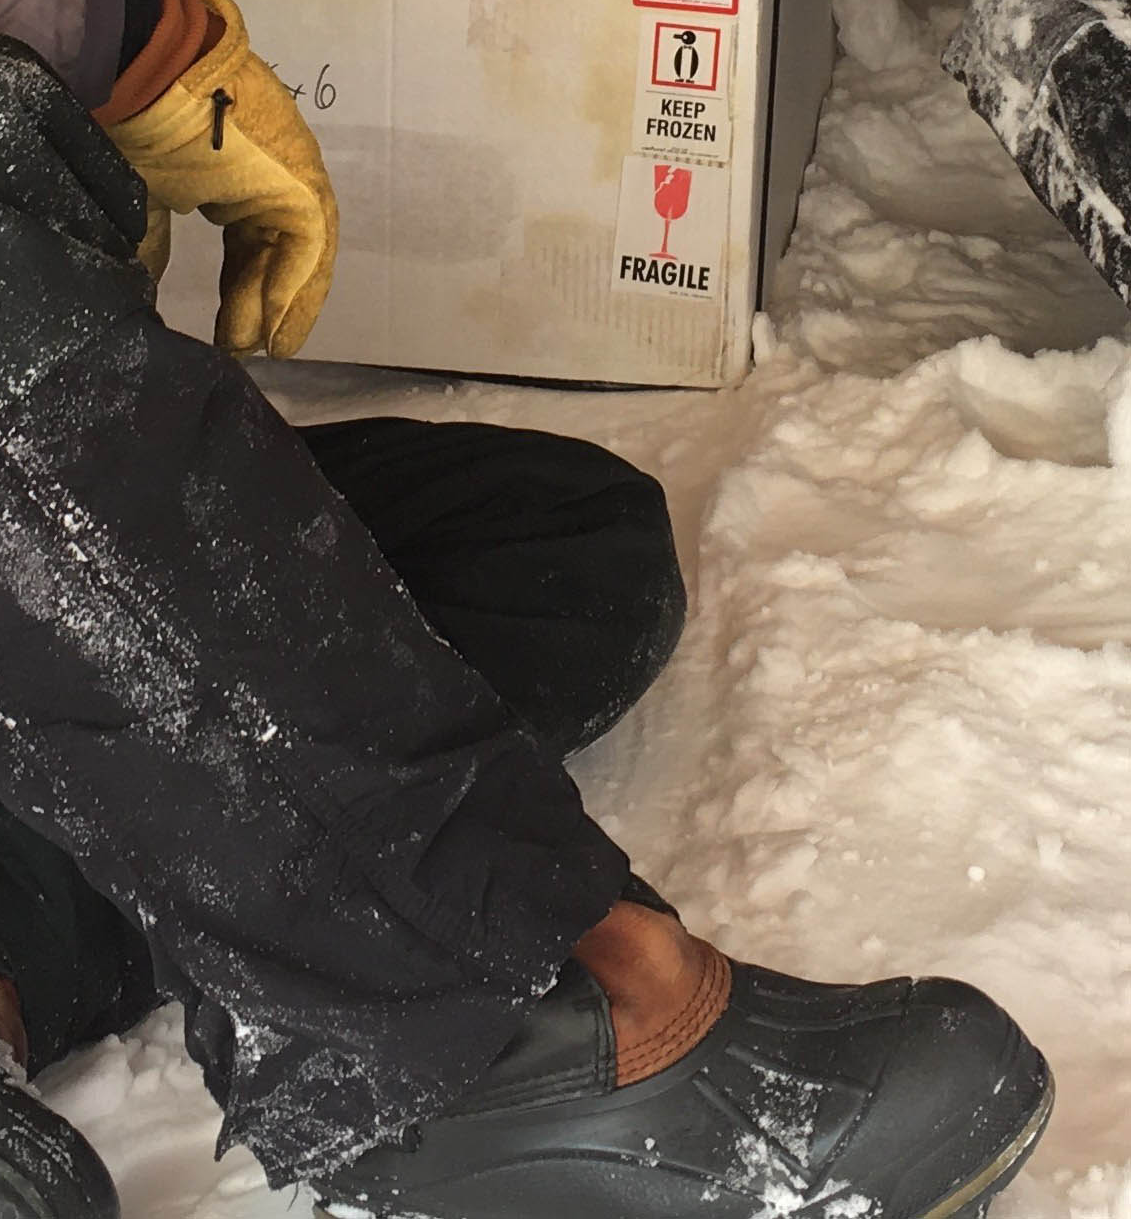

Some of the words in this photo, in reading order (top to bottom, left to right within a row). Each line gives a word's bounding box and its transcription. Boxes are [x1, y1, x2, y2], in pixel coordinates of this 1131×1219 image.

[659, 98, 706, 120] KEEP
[646, 118, 717, 143] FROZEN
[619, 255, 710, 291] FRAGILE
